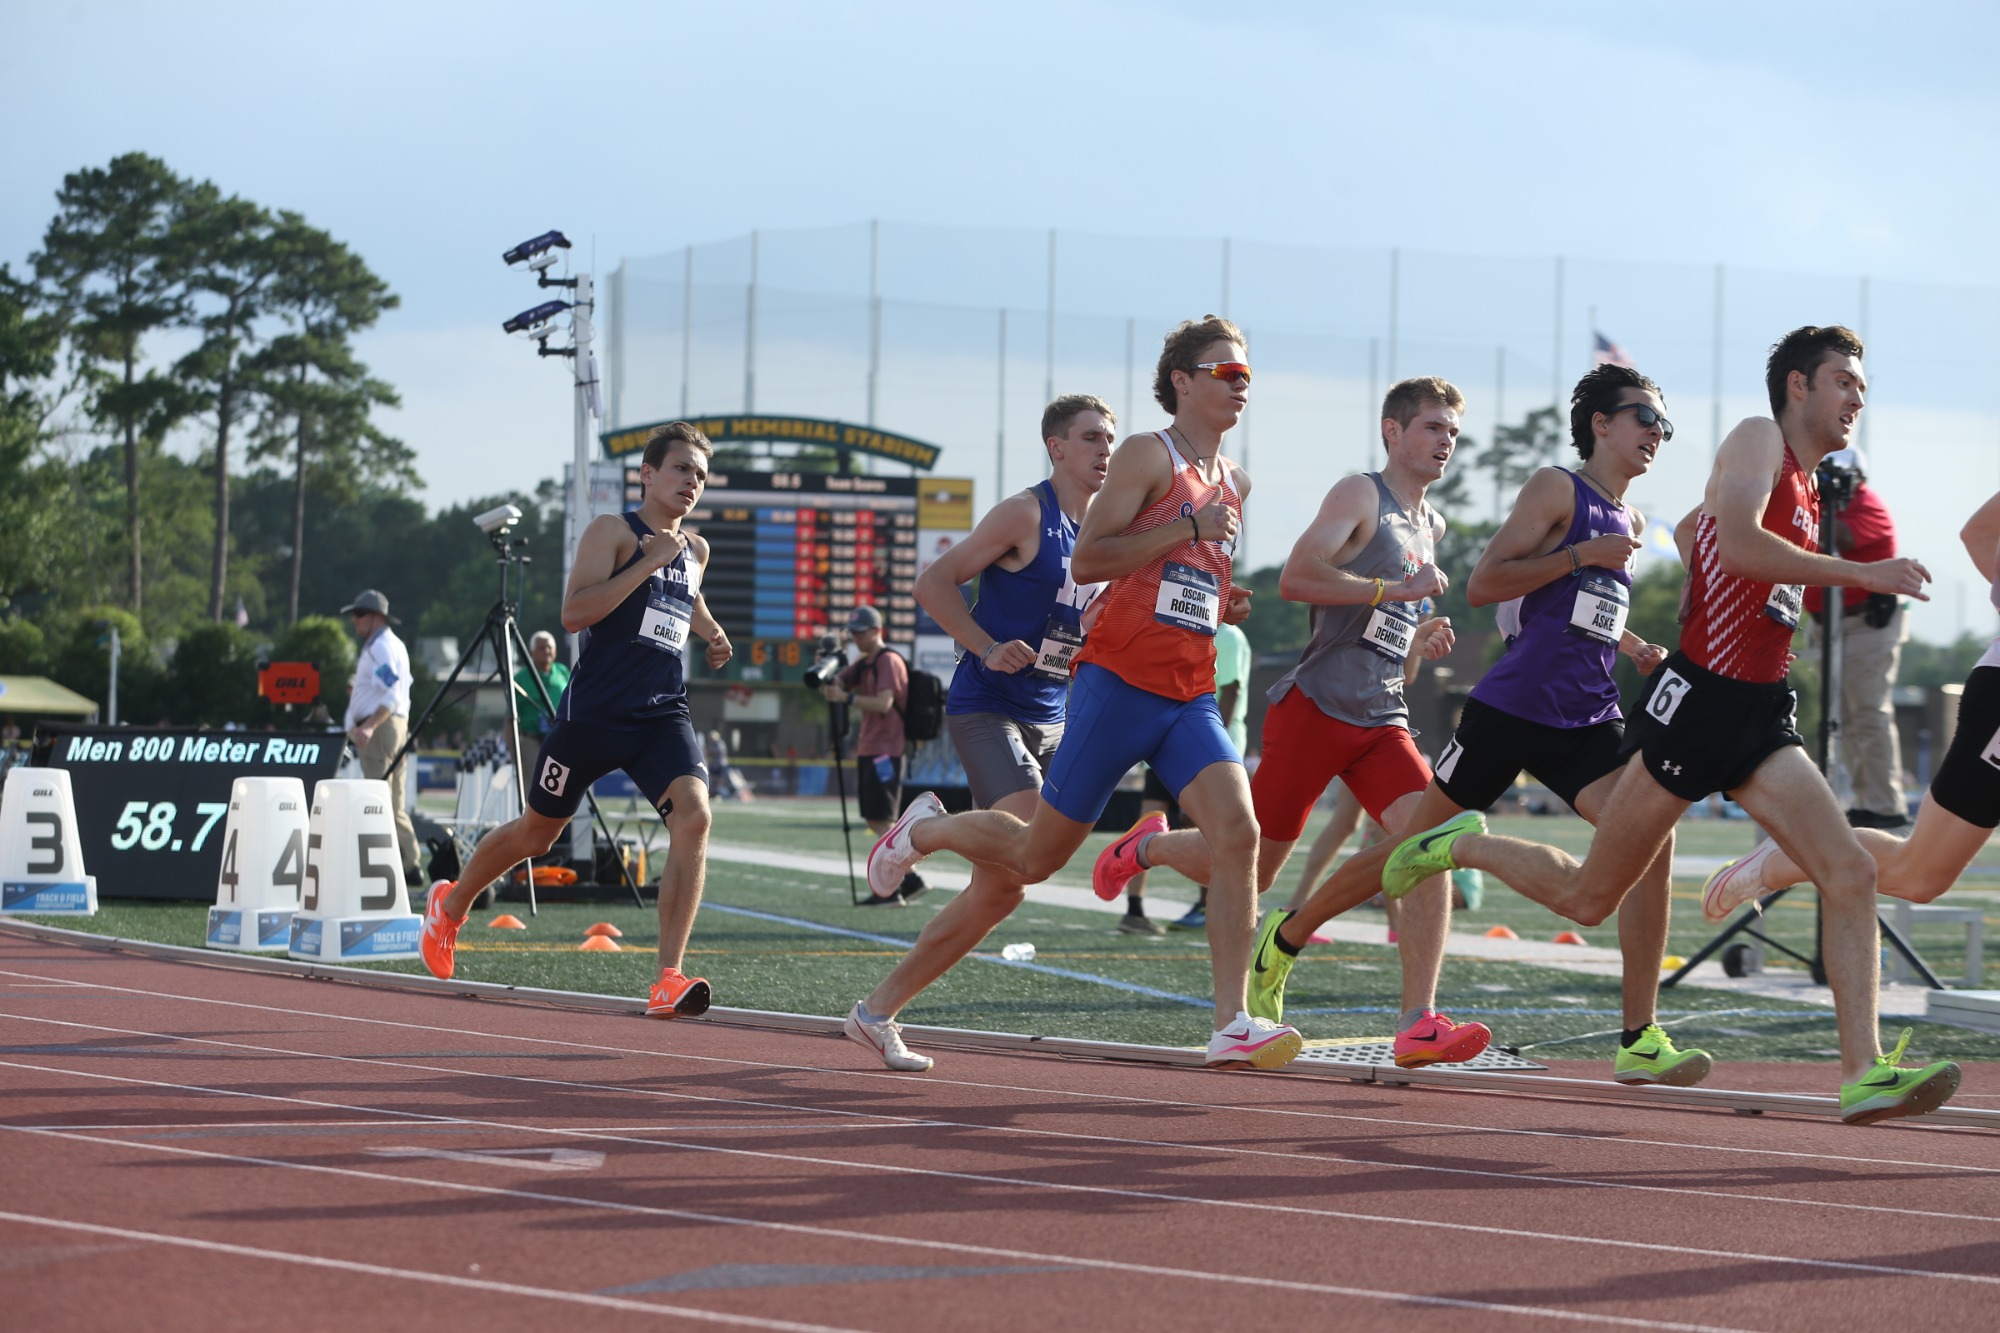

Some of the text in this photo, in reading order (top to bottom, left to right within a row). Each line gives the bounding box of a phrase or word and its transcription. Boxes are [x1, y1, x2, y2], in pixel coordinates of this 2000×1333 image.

[731, 418, 838, 440] MEMORIAL
[844, 428, 935, 465] STADIUM
[1182, 588, 1206, 603] OSCAR
[1170, 599, 1210, 621] ROERING
[1596, 600, 1618, 616] JULIAN
[668, 617, 676, 627] TJ
[1384, 616, 1408, 635] WILLIAM
[1592, 613, 1615, 631] ASKE
[654, 625, 682, 644] CARLEO
[1374, 626, 1408, 651] DEHMLER
[1059, 645, 1074, 656] JAKE
[1042, 654, 1070, 670] SHUMA
[275, 677, 307, 688] GILL
[1652, 677, 1682, 717] 6
[66, 736, 320, 764] Men 800 Meter Run
[544, 762, 563, 792] 8
[33, 788, 54, 797] GILL
[278, 802, 297, 811] GILL
[363, 805, 384, 815] GILL
[111, 801, 228, 852] 58.7
[26, 811, 64, 875] 3
[221, 828, 239, 903] 4
[272, 828, 304, 903] 4
[304, 833, 323, 911] 5
[357, 833, 397, 911] 5
[36, 893, 58, 903] TRACK
[66, 893, 86, 903] FIELD
[373, 932, 395, 943] TRACK
